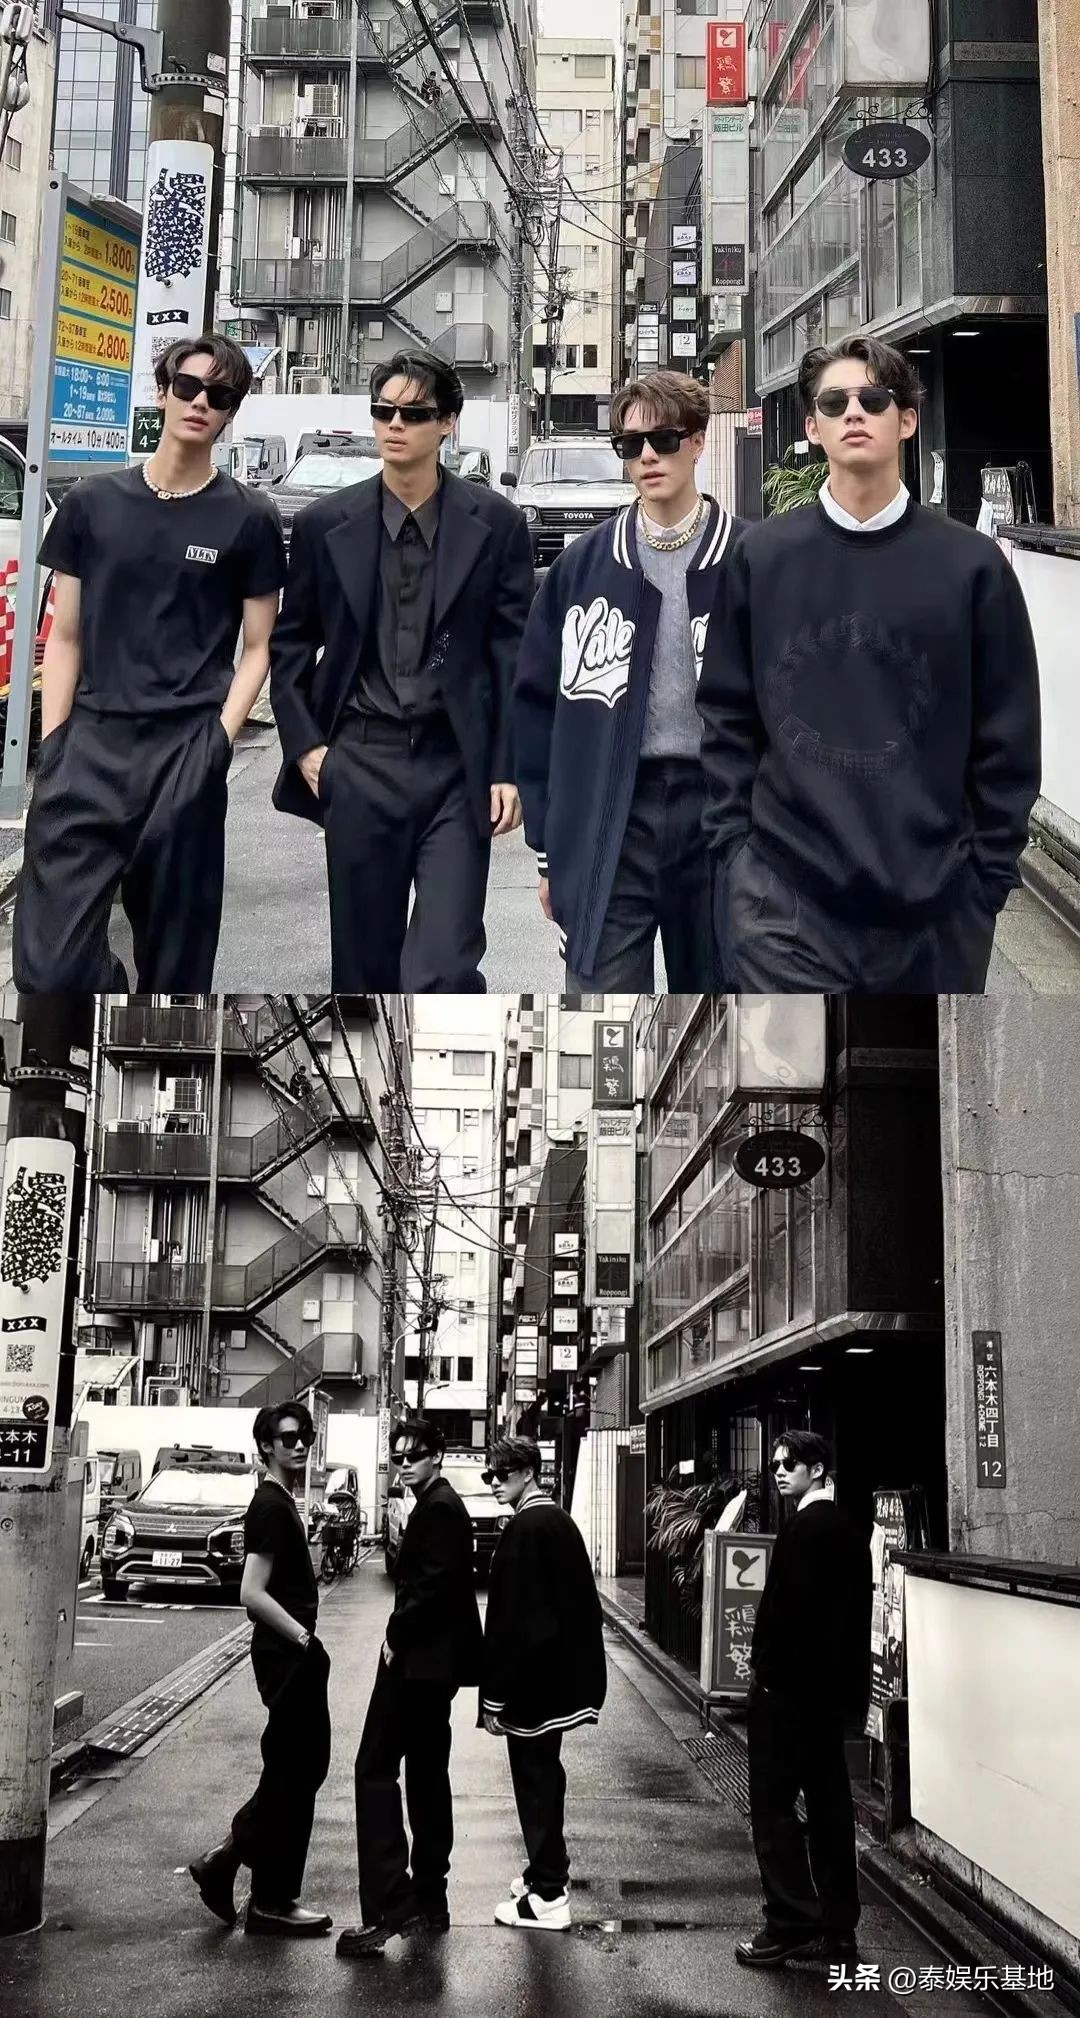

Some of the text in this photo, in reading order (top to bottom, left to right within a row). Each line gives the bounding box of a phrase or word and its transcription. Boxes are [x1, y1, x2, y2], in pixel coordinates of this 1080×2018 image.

[862, 147, 908, 168] 433
[190, 547, 214, 560] VLTN
[754, 1156, 802, 1177] 433
[976, 1364, 985, 1401] ROPPONGI
[984, 1365, 999, 1448] 六本木四丁目
[979, 1435, 987, 1448] 12
[0, 1449, 31, 1463] -11
[981, 1460, 1002, 1477] 12
